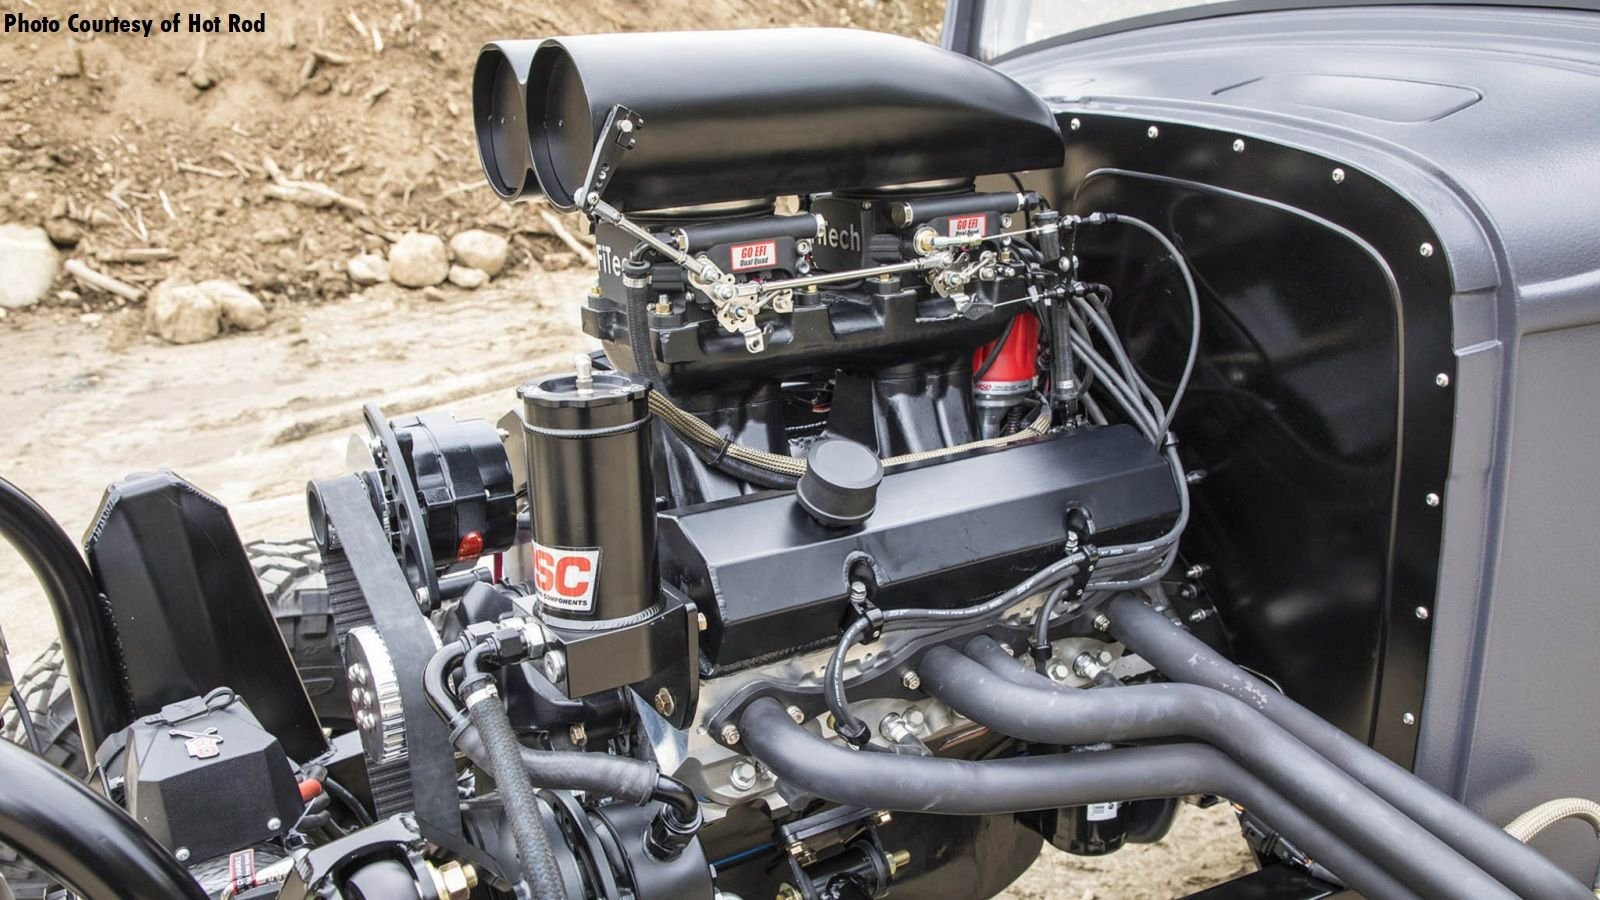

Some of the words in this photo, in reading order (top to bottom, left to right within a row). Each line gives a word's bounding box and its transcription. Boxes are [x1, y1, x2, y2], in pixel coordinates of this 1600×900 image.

[957, 220, 967, 230] GO
[968, 219, 978, 229] EFI
[741, 247, 753, 258] GO
[754, 245, 767, 257] EFI
[740, 259, 753, 267] Dual
[754, 256, 769, 266] Quad
[532, 549, 591, 597] SC
[543, 593, 588, 607] COMPONENTS
